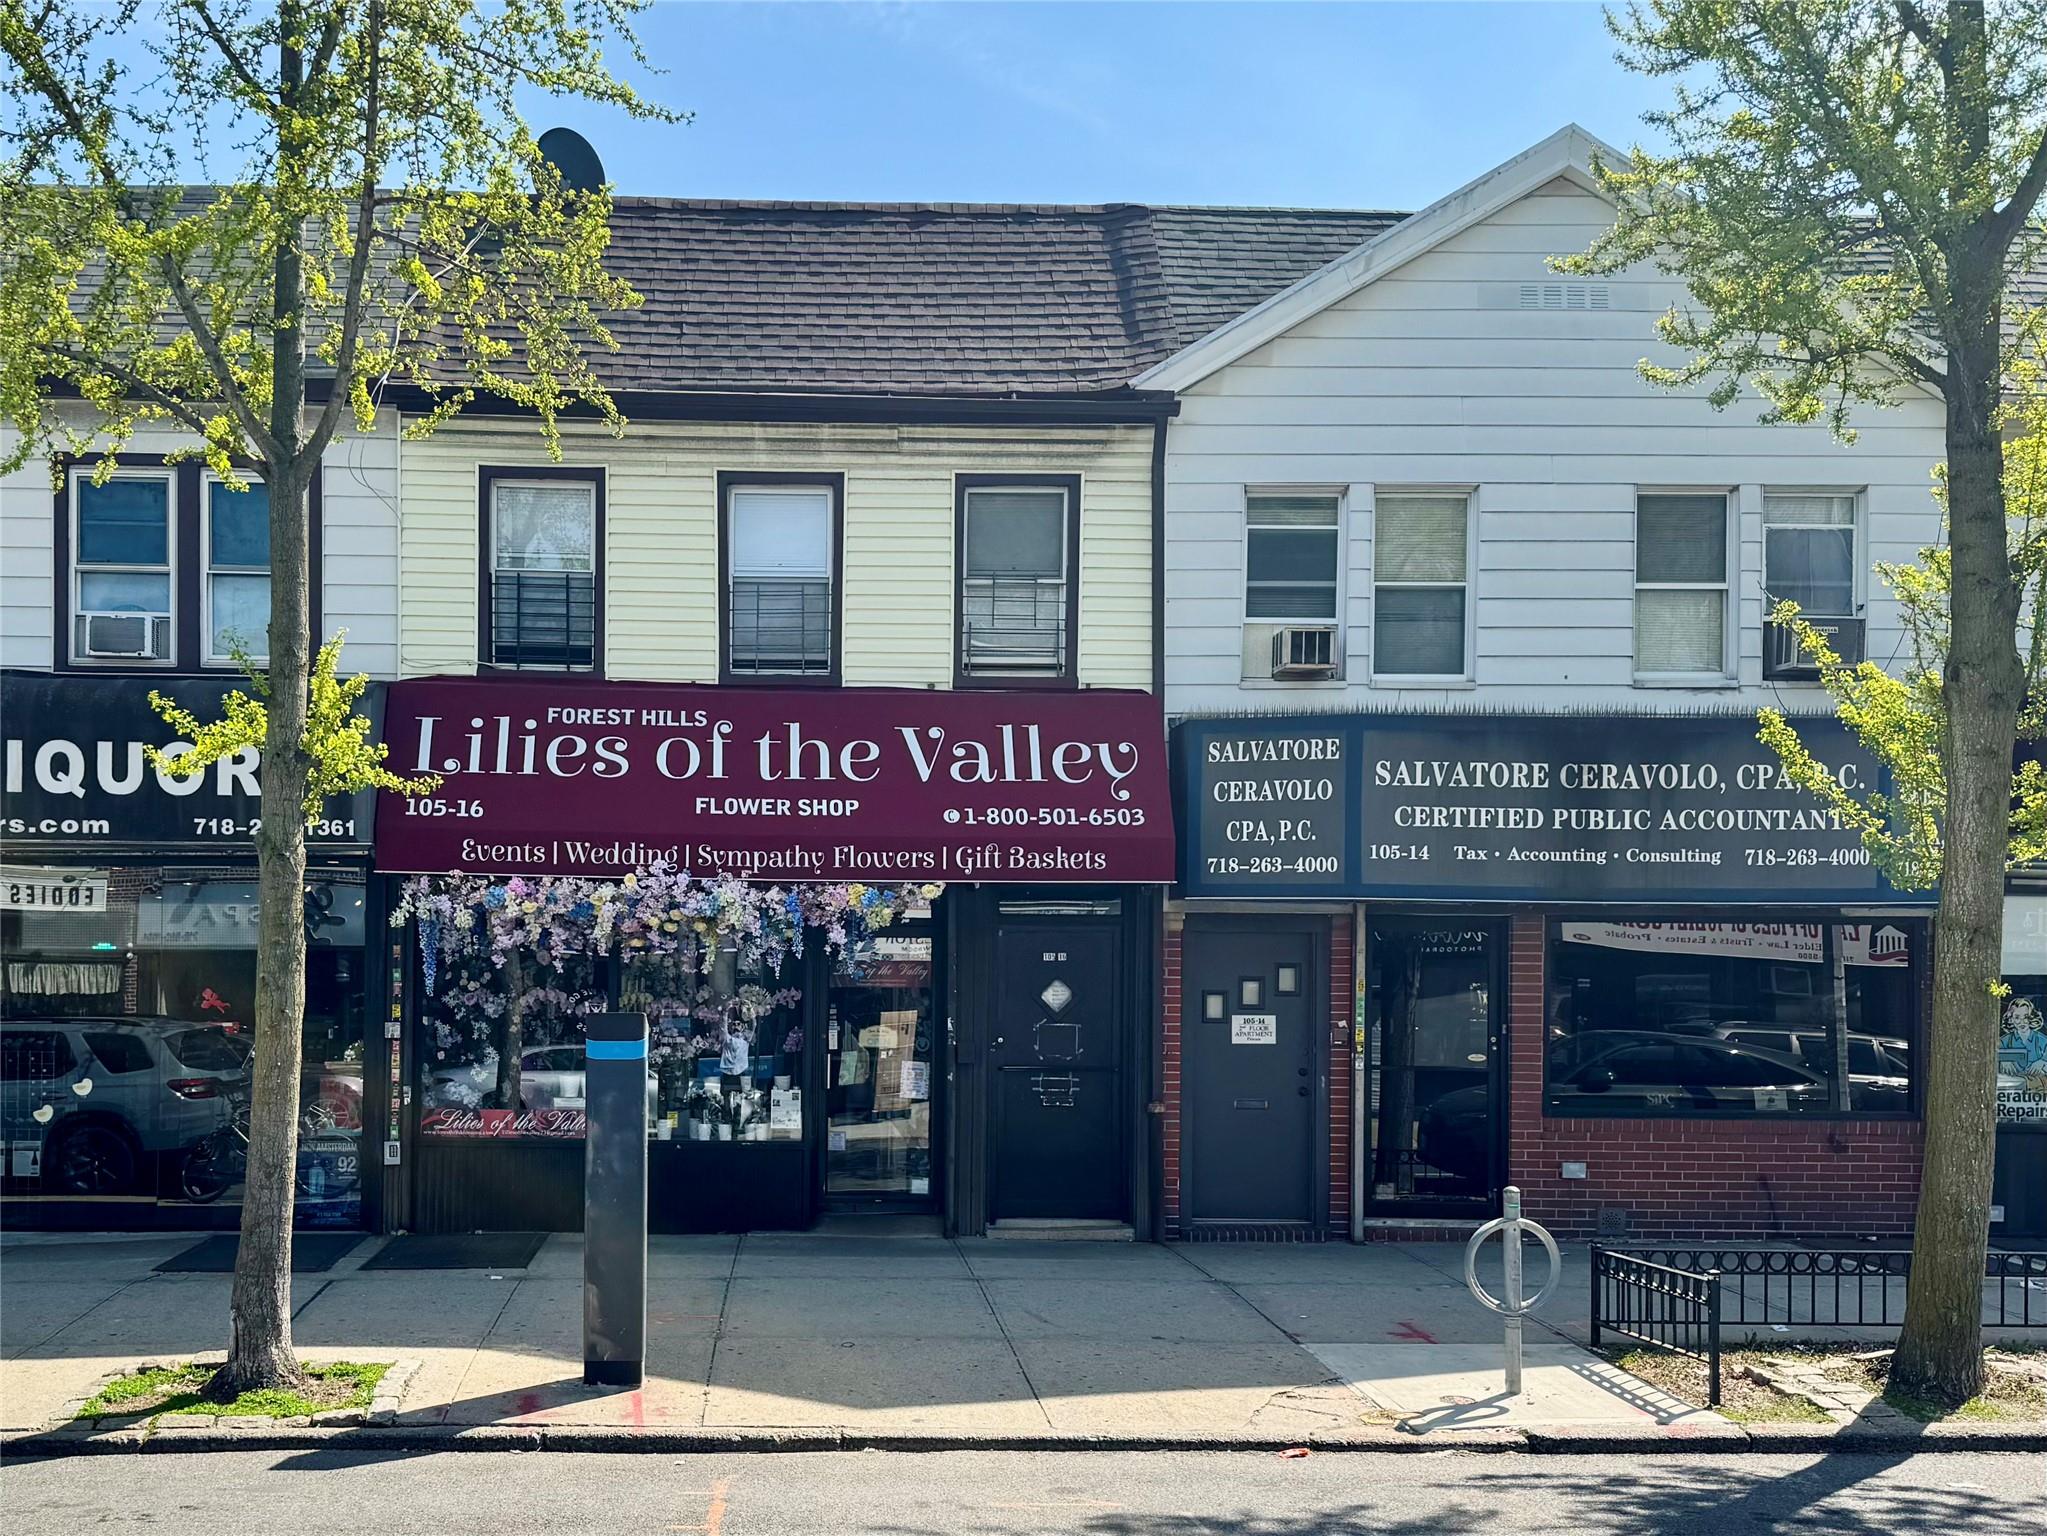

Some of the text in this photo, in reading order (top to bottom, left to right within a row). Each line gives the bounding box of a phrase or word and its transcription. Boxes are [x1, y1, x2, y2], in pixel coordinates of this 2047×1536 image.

[547, 707, 708, 727] FOREST HILLS
[410, 716, 1138, 801] Lilies of the Valley
[1208, 738, 1340, 763] SALVATORE
[1375, 760, 1549, 789] SALVATORE
[1560, 763, 1727, 794] CERAVOLO,
[1736, 764, 1802, 794] CPA,
[1213, 778, 1333, 802] CERAVOLO
[405, 797, 1145, 826] 105-16 FLOWER SHOP 1-800-501-6503
[1394, 805, 1544, 829] CERTIFIED
[1552, 808, 1651, 831] PUBLIC
[462, 838, 1107, 875] Events Wedding Sympathy Flowers Gift Baskets
[1207, 856, 1338, 874] 718-263-4000
[1370, 844, 1871, 867] 105-14 Tax Accounting Consulting 718-263-4000
[433, 1108, 587, 1137] Lilies of the Vall
[1997, 1103, 2047, 1122] Repair
[337, 1156, 357, 1173] 92
